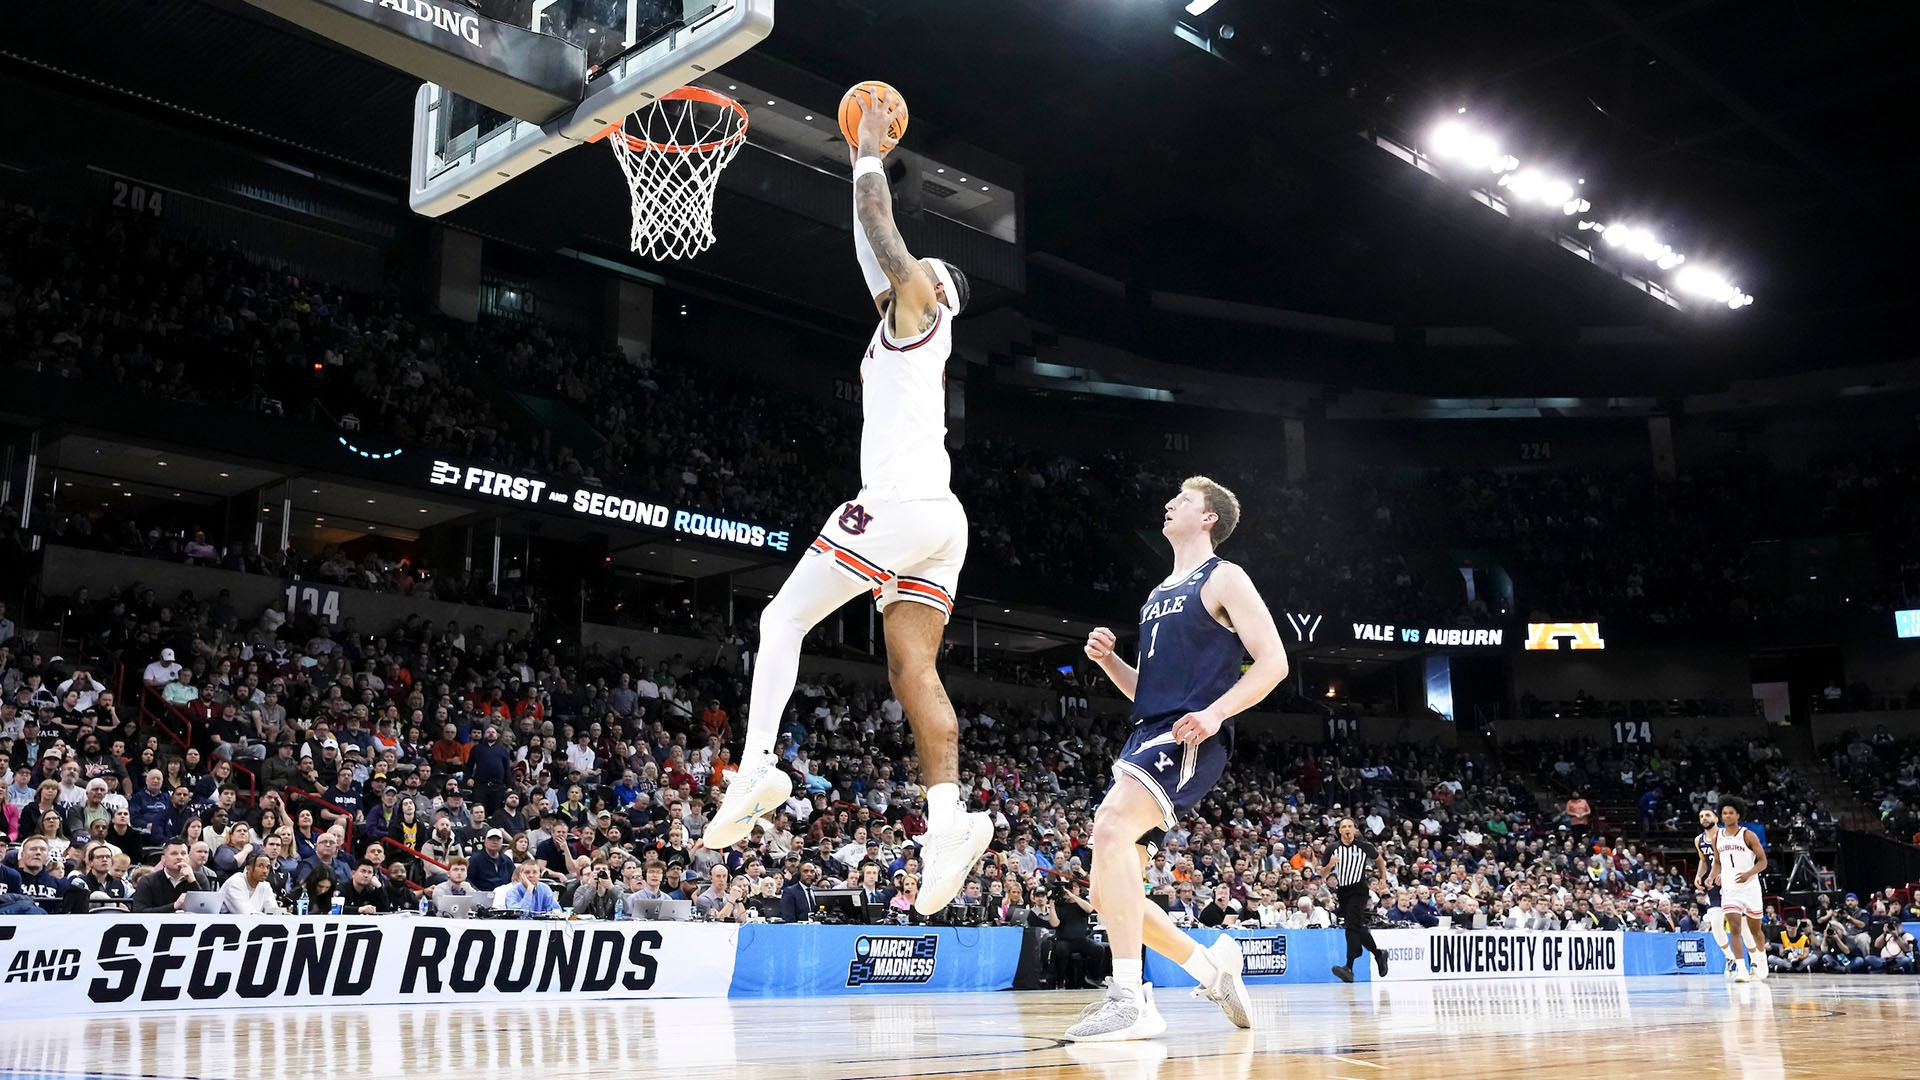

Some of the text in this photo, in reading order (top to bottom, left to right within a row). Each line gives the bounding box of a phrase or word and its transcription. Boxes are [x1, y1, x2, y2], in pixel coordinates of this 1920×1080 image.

[112, 181, 163, 217] 204
[1163, 432, 1191, 451] 201
[1520, 442, 1552, 460] 224
[464, 467, 766, 547] FIRST AND SECOND ROUNDS
[1139, 595, 1187, 625] YALE
[1147, 622, 1160, 659] 1
[1353, 623, 1503, 646] YALE VS AUBURN
[1614, 721, 1652, 743] 124
[869, 939, 915, 958] MARCH
[1242, 939, 1272, 955] MARCH
[1415, 948, 1425, 961] BY
[1430, 935, 1616, 973] UNIVERSITY OF IDAHO
[5, 923, 663, 1003] AND SECOND ROUNDS
[873, 957, 934, 976] MADNESS
[1247, 954, 1286, 970] MADNESS
